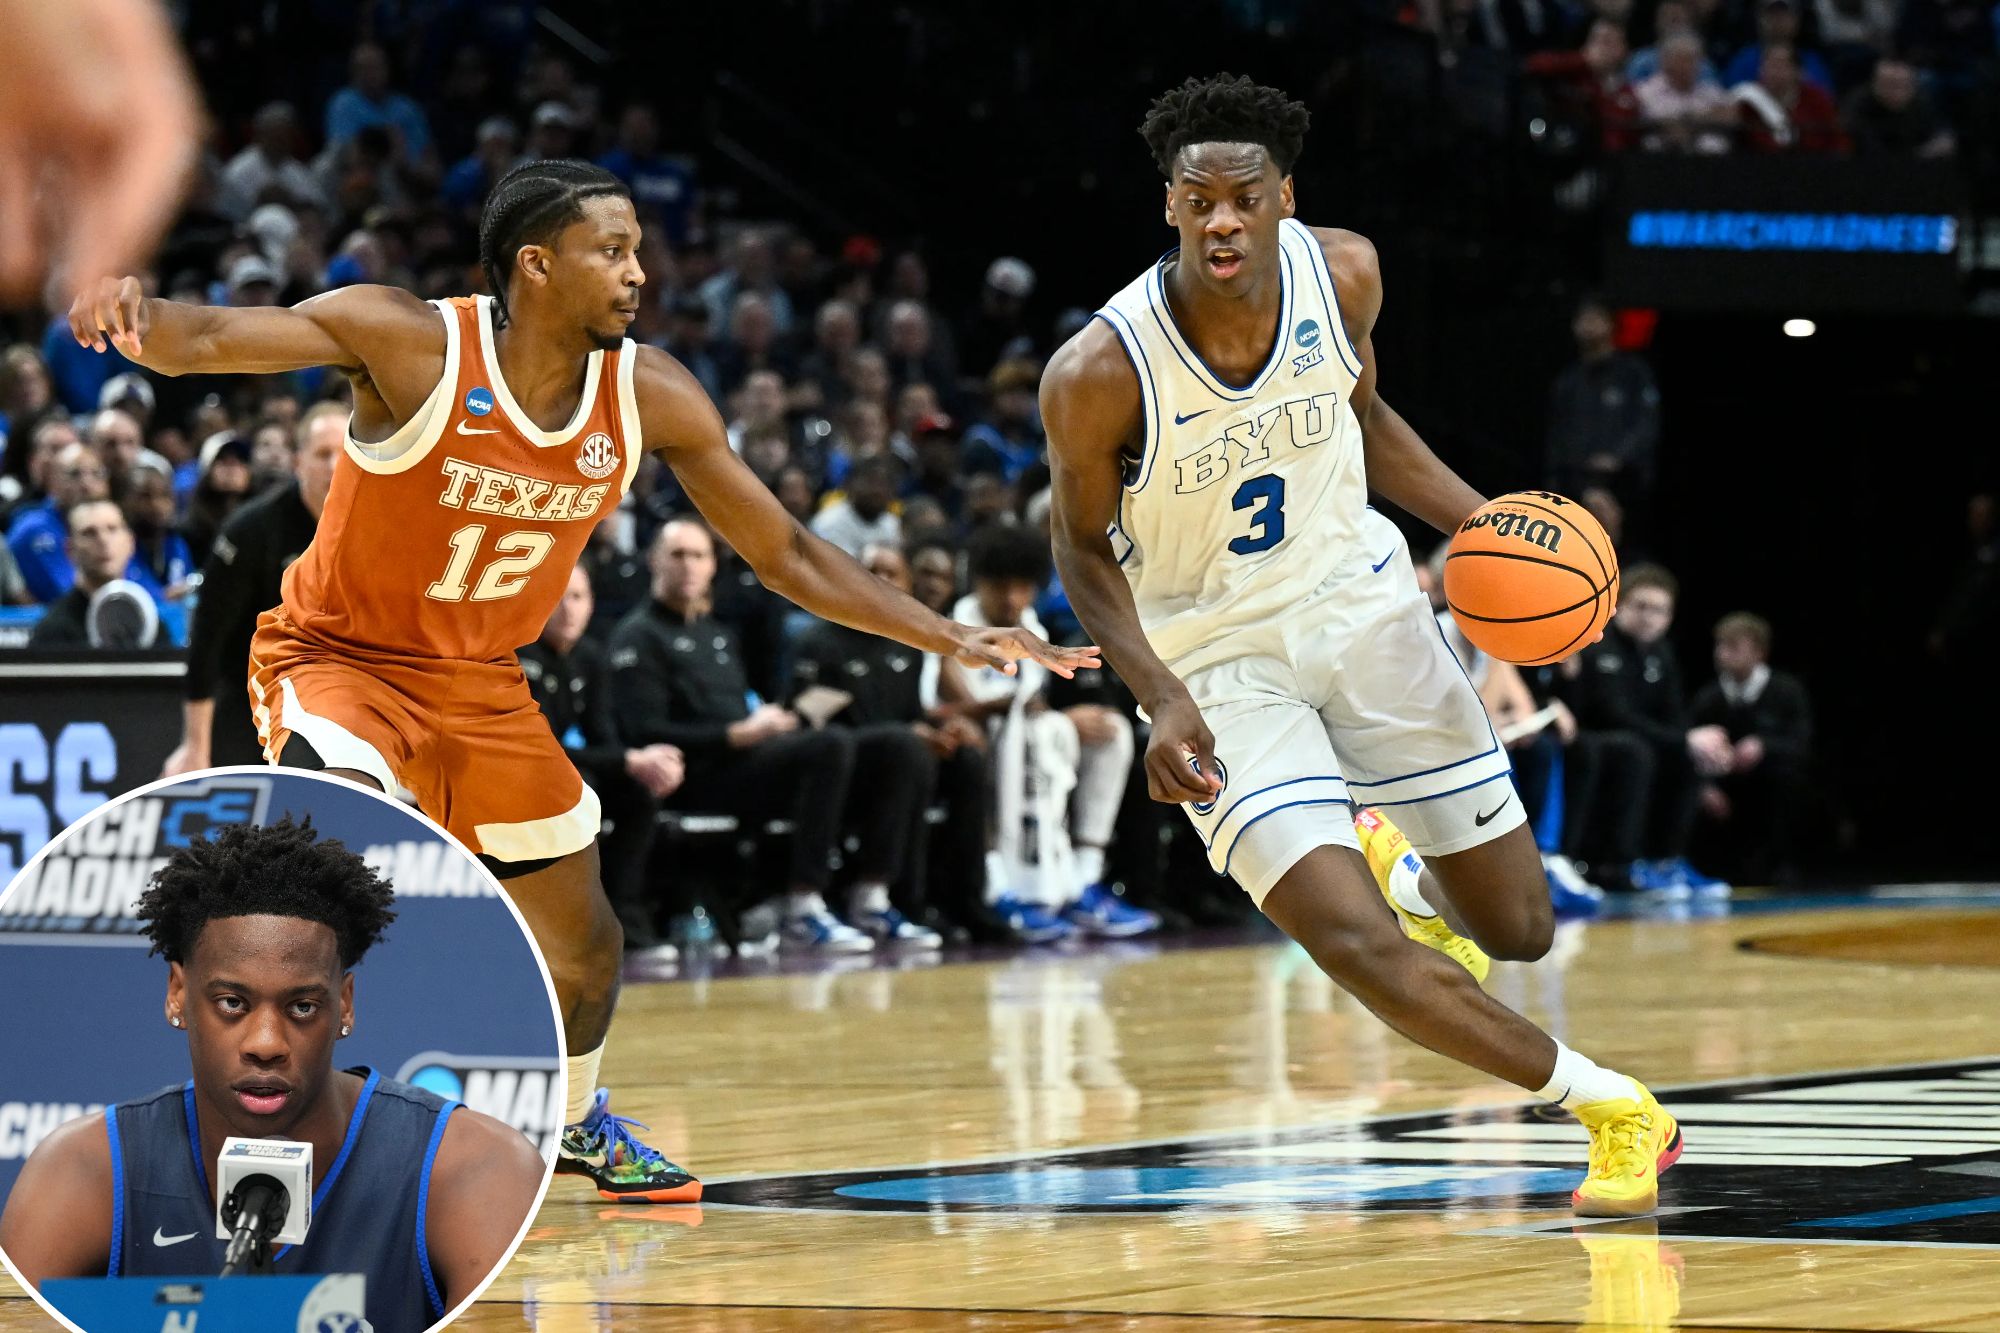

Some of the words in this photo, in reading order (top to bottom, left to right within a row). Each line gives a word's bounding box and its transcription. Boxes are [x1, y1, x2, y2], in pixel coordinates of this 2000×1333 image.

[1300, 328, 1319, 343] NCAA
[468, 398, 491, 412] NCAA
[584, 435, 612, 467] SEC
[1175, 392, 1337, 494] BYU
[439, 457, 612, 521] TEXAS
[579, 463, 615, 478] GRADUATE
[1228, 473, 1285, 555] 3
[1461, 512, 1563, 554] Wilson
[425, 524, 555, 602] 12
[2, 857, 170, 918] MADN
